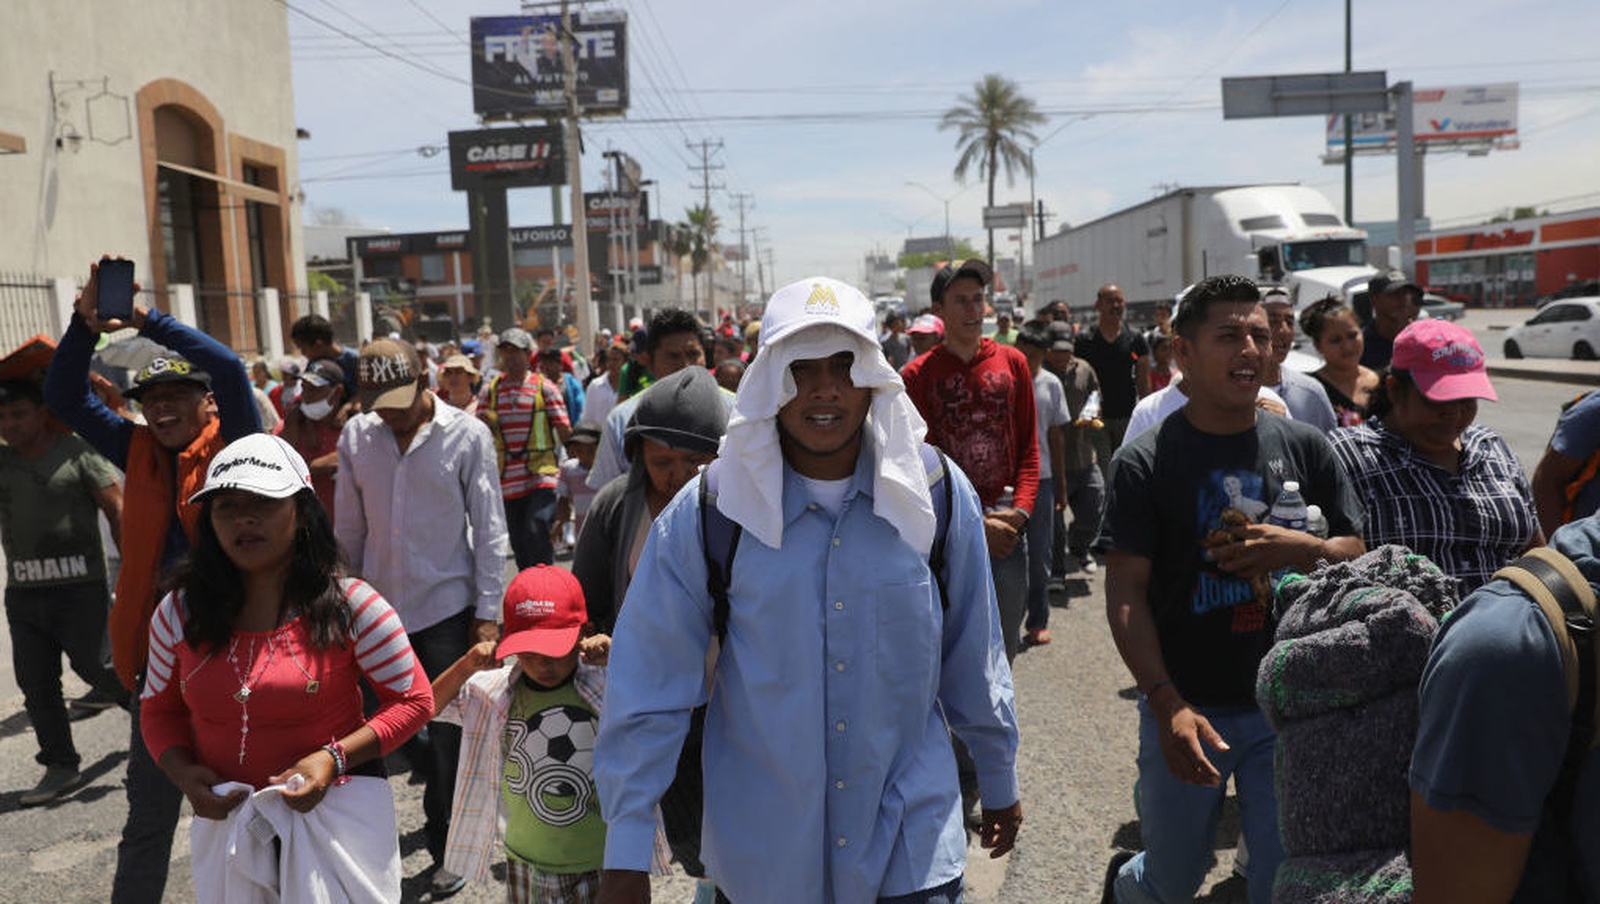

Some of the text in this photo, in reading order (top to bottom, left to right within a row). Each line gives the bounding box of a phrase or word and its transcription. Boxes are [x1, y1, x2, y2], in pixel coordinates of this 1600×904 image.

[467, 143, 527, 162] CASE
[212, 456, 282, 478] TaylorMade
[12, 555, 88, 582] CHAIN
